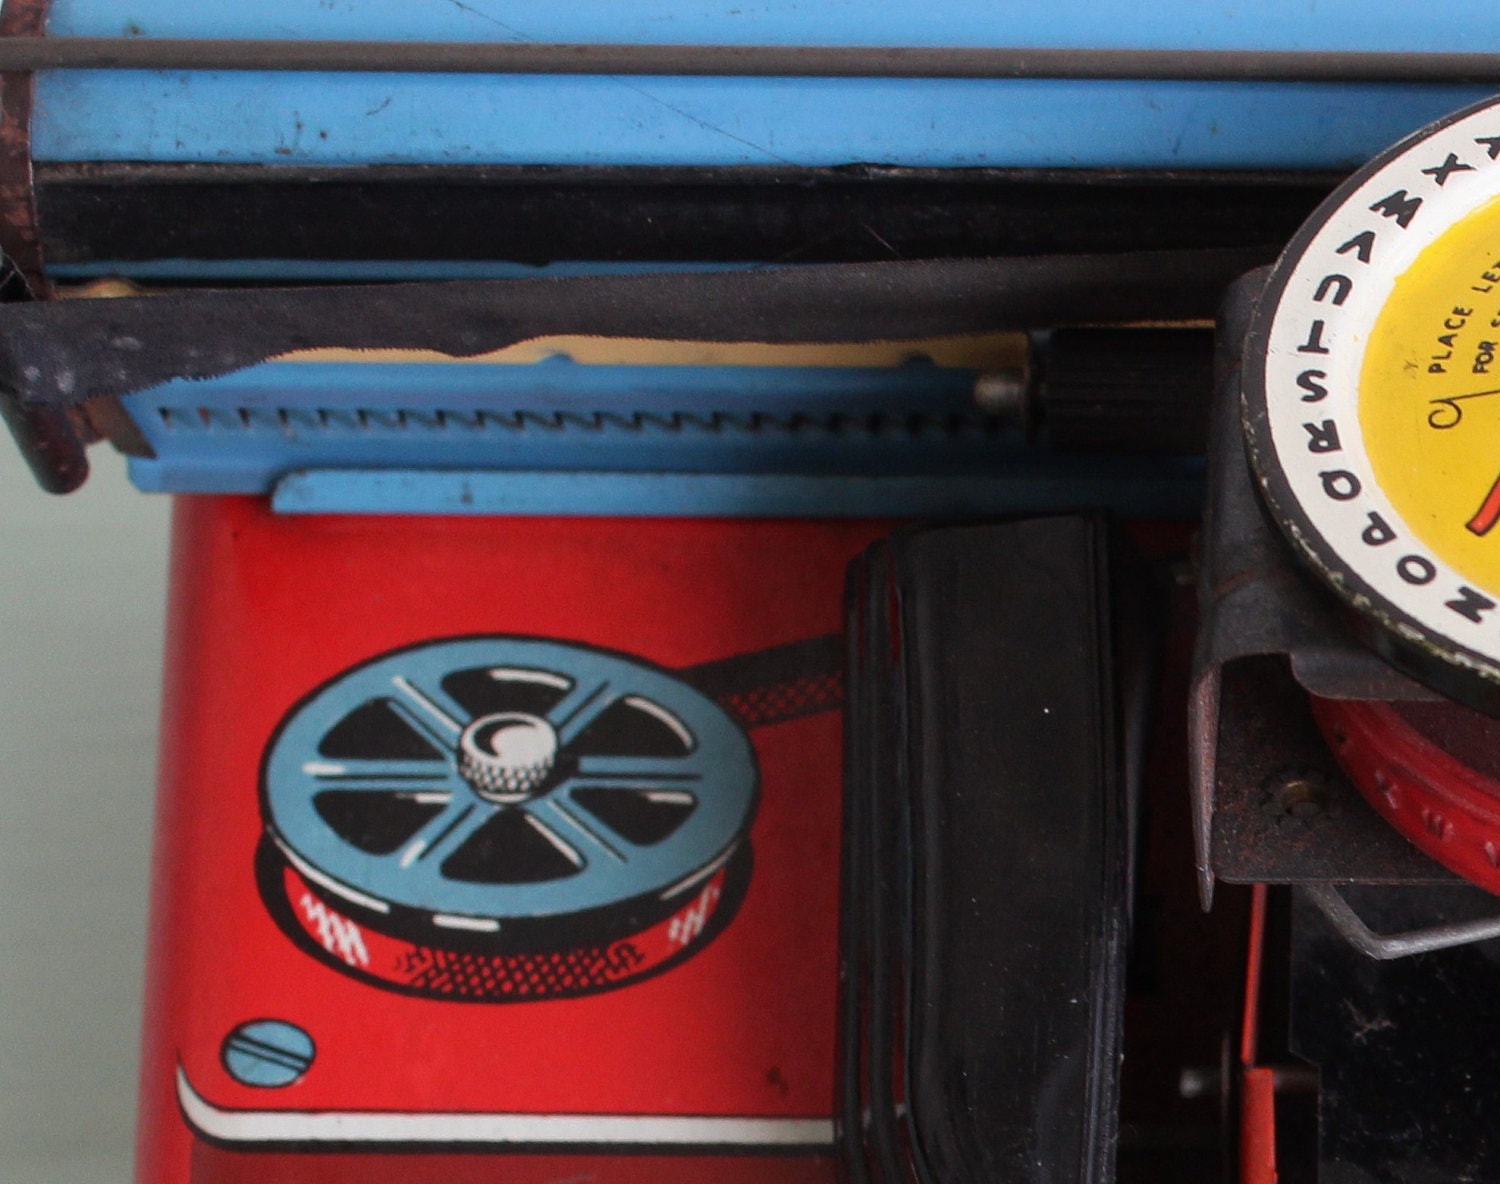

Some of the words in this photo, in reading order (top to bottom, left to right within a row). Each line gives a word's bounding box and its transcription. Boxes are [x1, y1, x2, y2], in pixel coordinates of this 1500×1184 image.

[1422, 153, 1475, 186] X
[1369, 190, 1422, 229] W
[1336, 231, 1375, 263] V
[1313, 274, 1352, 305] U
[1297, 320, 1329, 354] T
[1428, 306, 1473, 374] PLACE
[1472, 340, 1499, 374] FOR
[1297, 370, 1327, 402] S
[1303, 420, 1341, 453] R
[1319, 470, 1361, 501] Q
[1362, 512, 1396, 546] P
[1397, 555, 1436, 585] O
[1445, 587, 1495, 623] N
